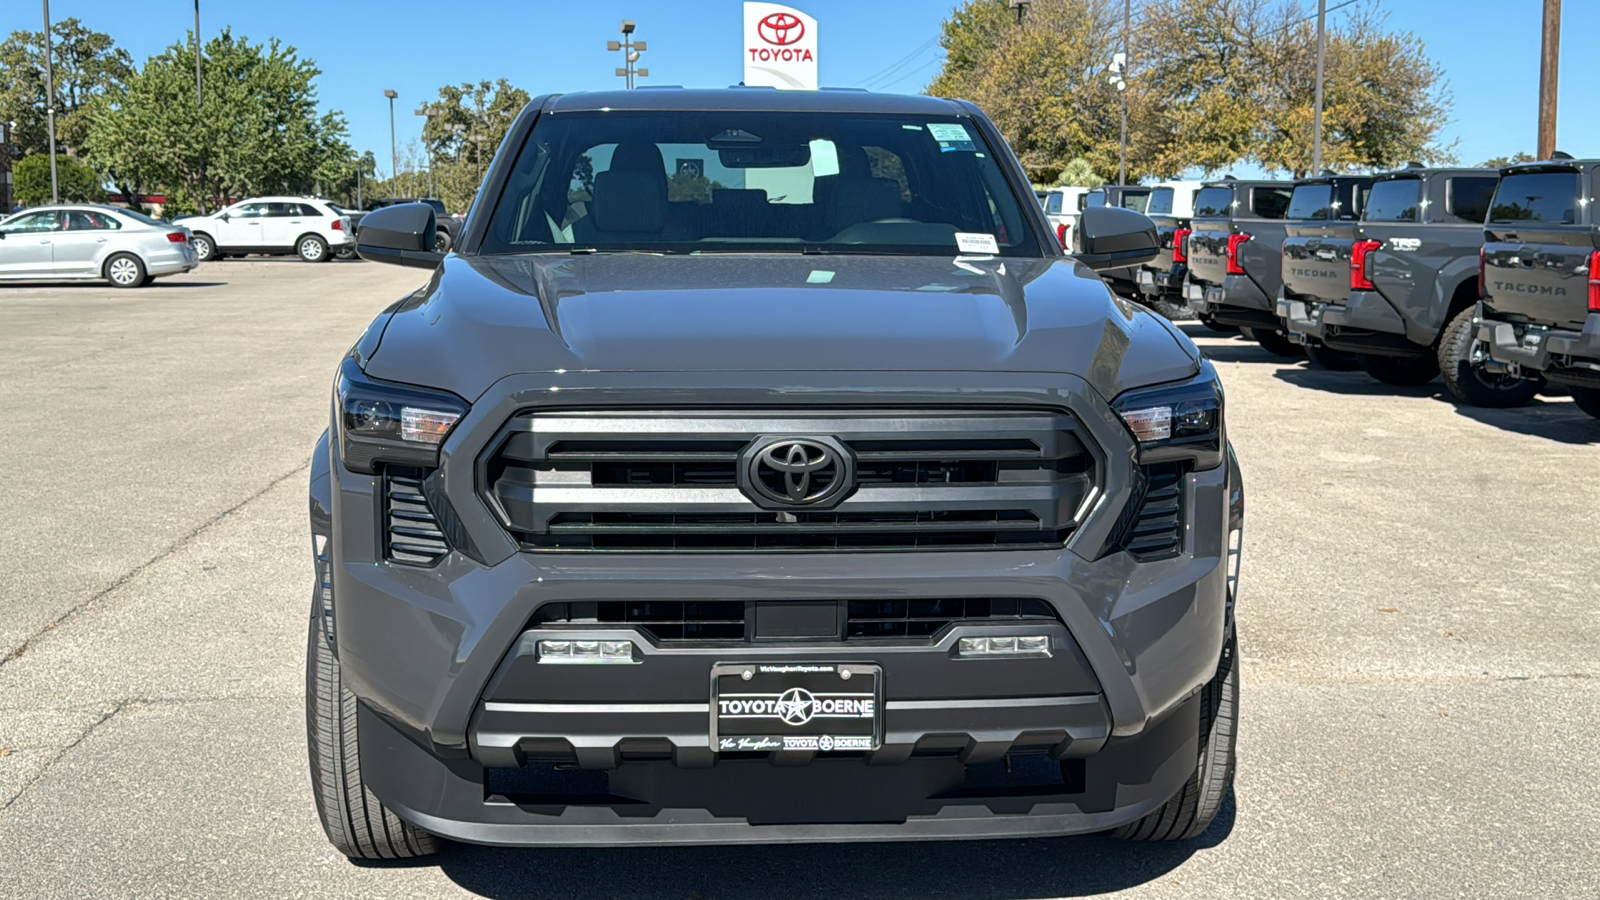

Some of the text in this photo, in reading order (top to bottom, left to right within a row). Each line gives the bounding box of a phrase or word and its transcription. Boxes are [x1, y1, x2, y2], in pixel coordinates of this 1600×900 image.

[749, 48, 813, 62] TOYOTA
[1389, 237, 1422, 248] TRD
[1191, 257, 1219, 265] TACOMA
[1291, 267, 1338, 279] TACOMA
[1494, 281, 1567, 296] TACOMA
[759, 665, 834, 673] VicVaughanToyota.com
[719, 700, 787, 714] TOYOTA
[812, 699, 874, 713] BOERNE
[738, 736, 781, 750] Vaughan
[783, 739, 818, 747] TOYOTA
[834, 739, 872, 747] BOERNE
